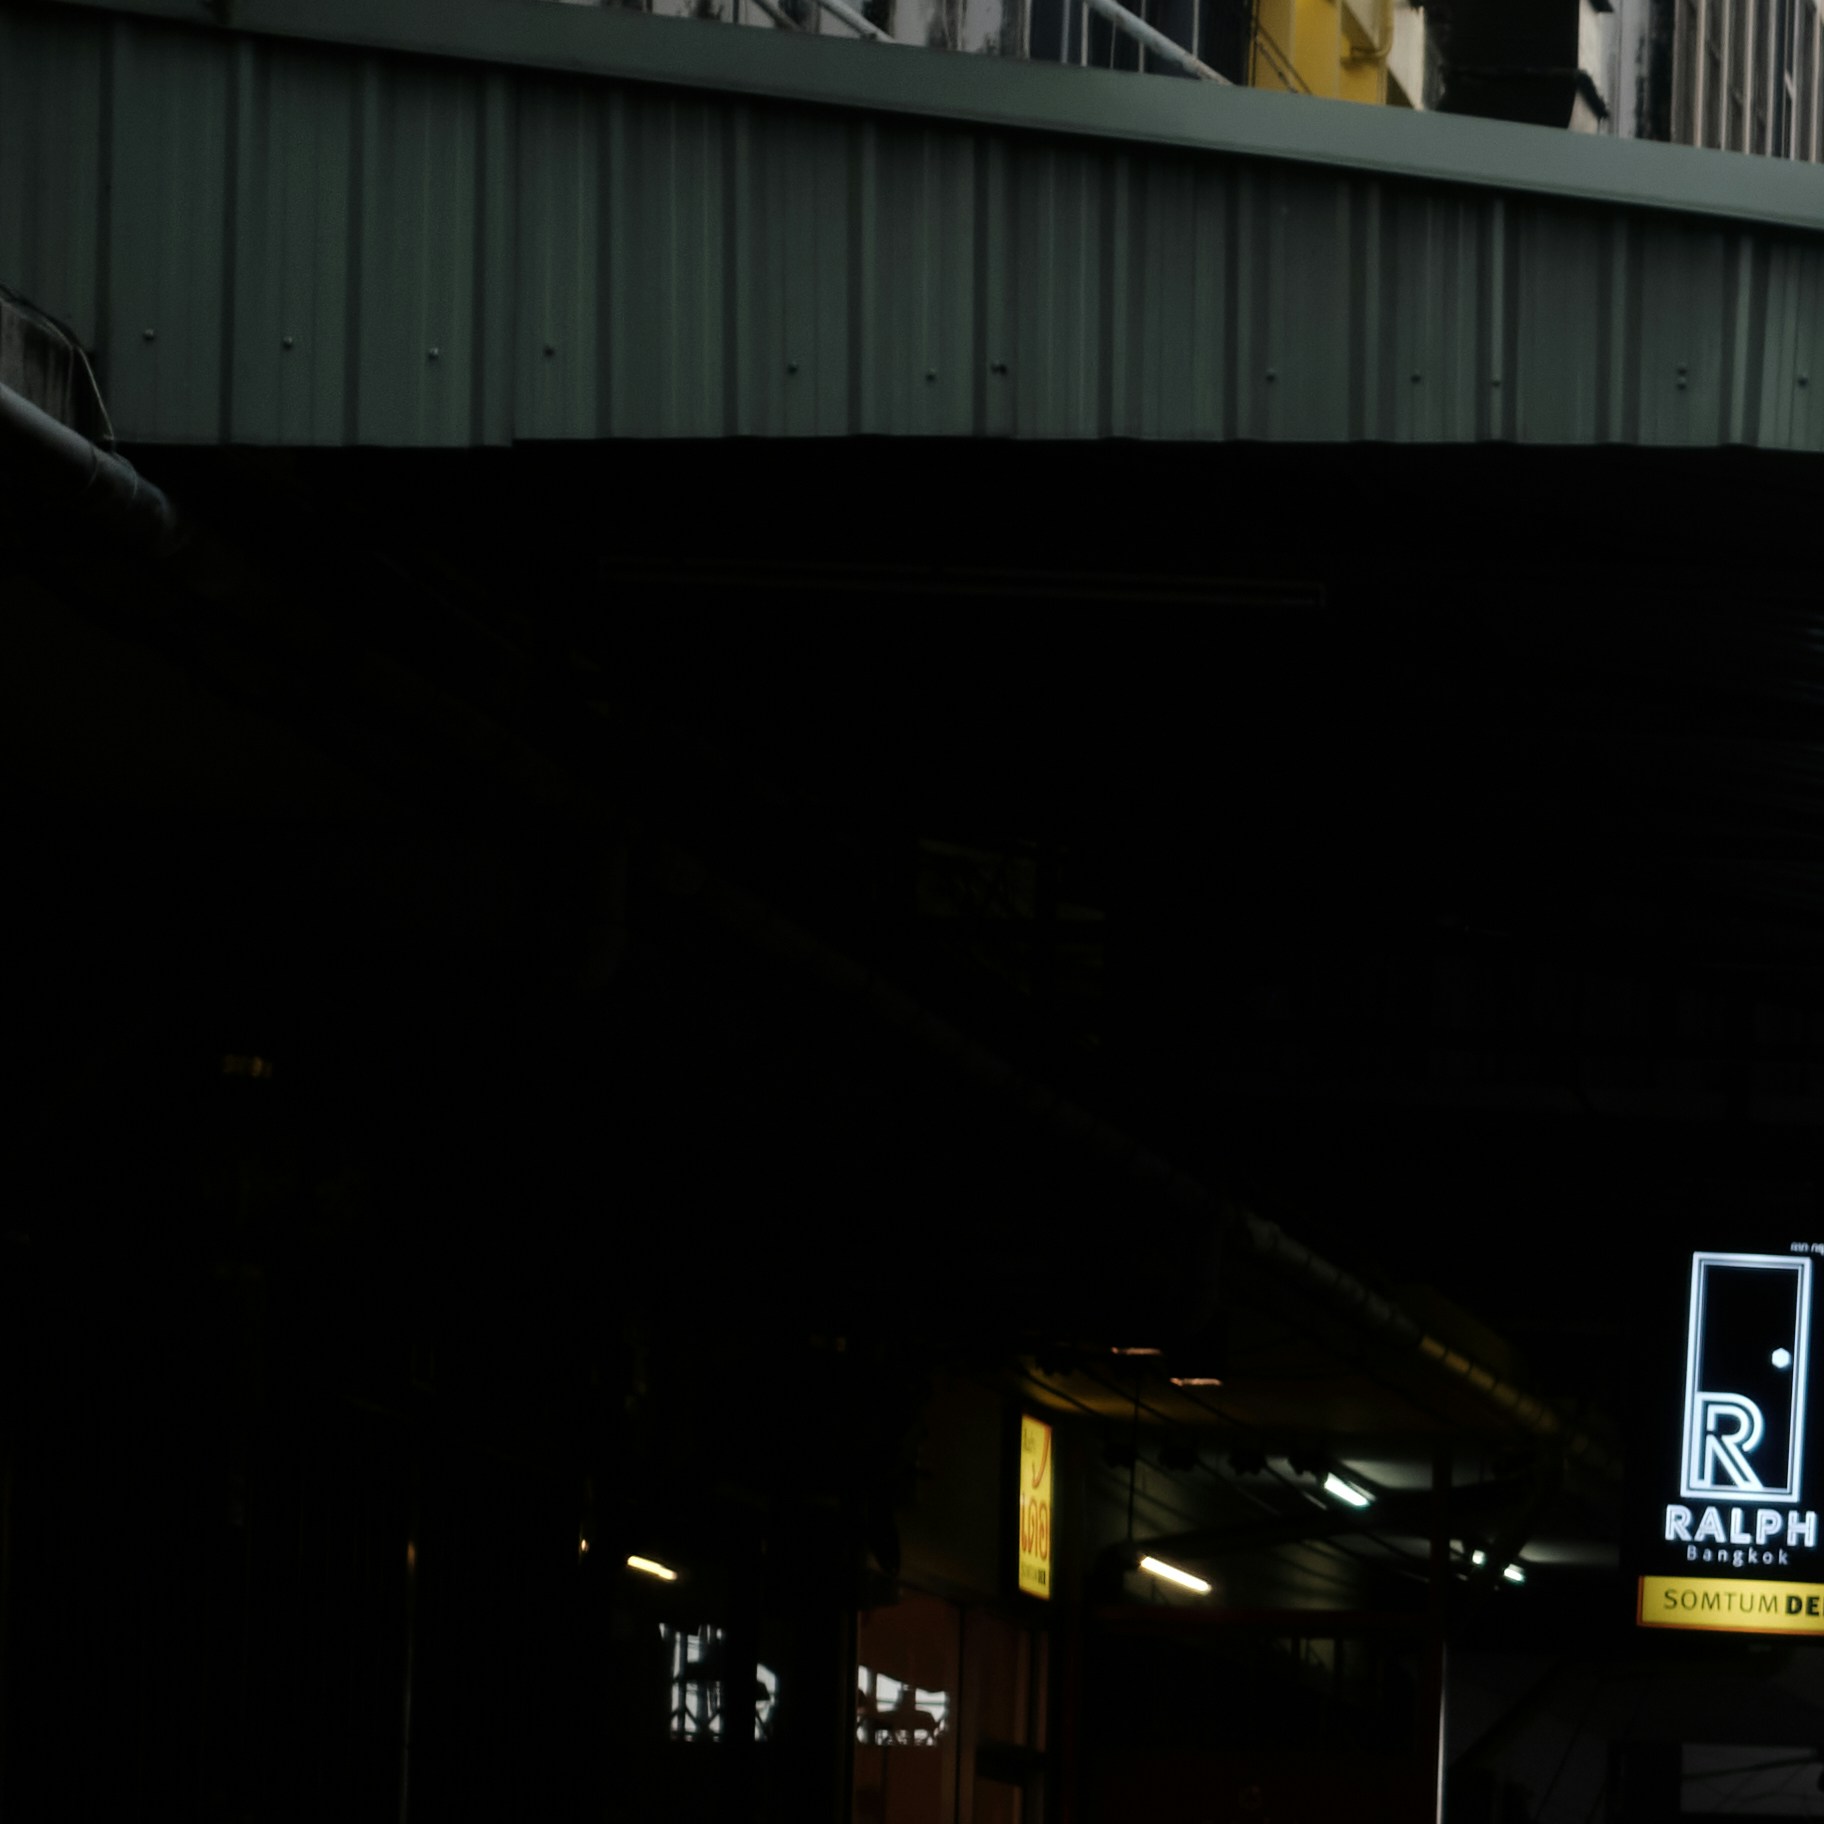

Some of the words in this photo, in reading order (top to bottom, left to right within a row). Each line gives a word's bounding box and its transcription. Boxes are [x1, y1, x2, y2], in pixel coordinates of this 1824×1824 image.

[1665, 1504, 1818, 1547] RALPH
[1686, 1545, 1790, 1568] Bangkok
[1663, 1588, 1778, 1614] SOMTUM
